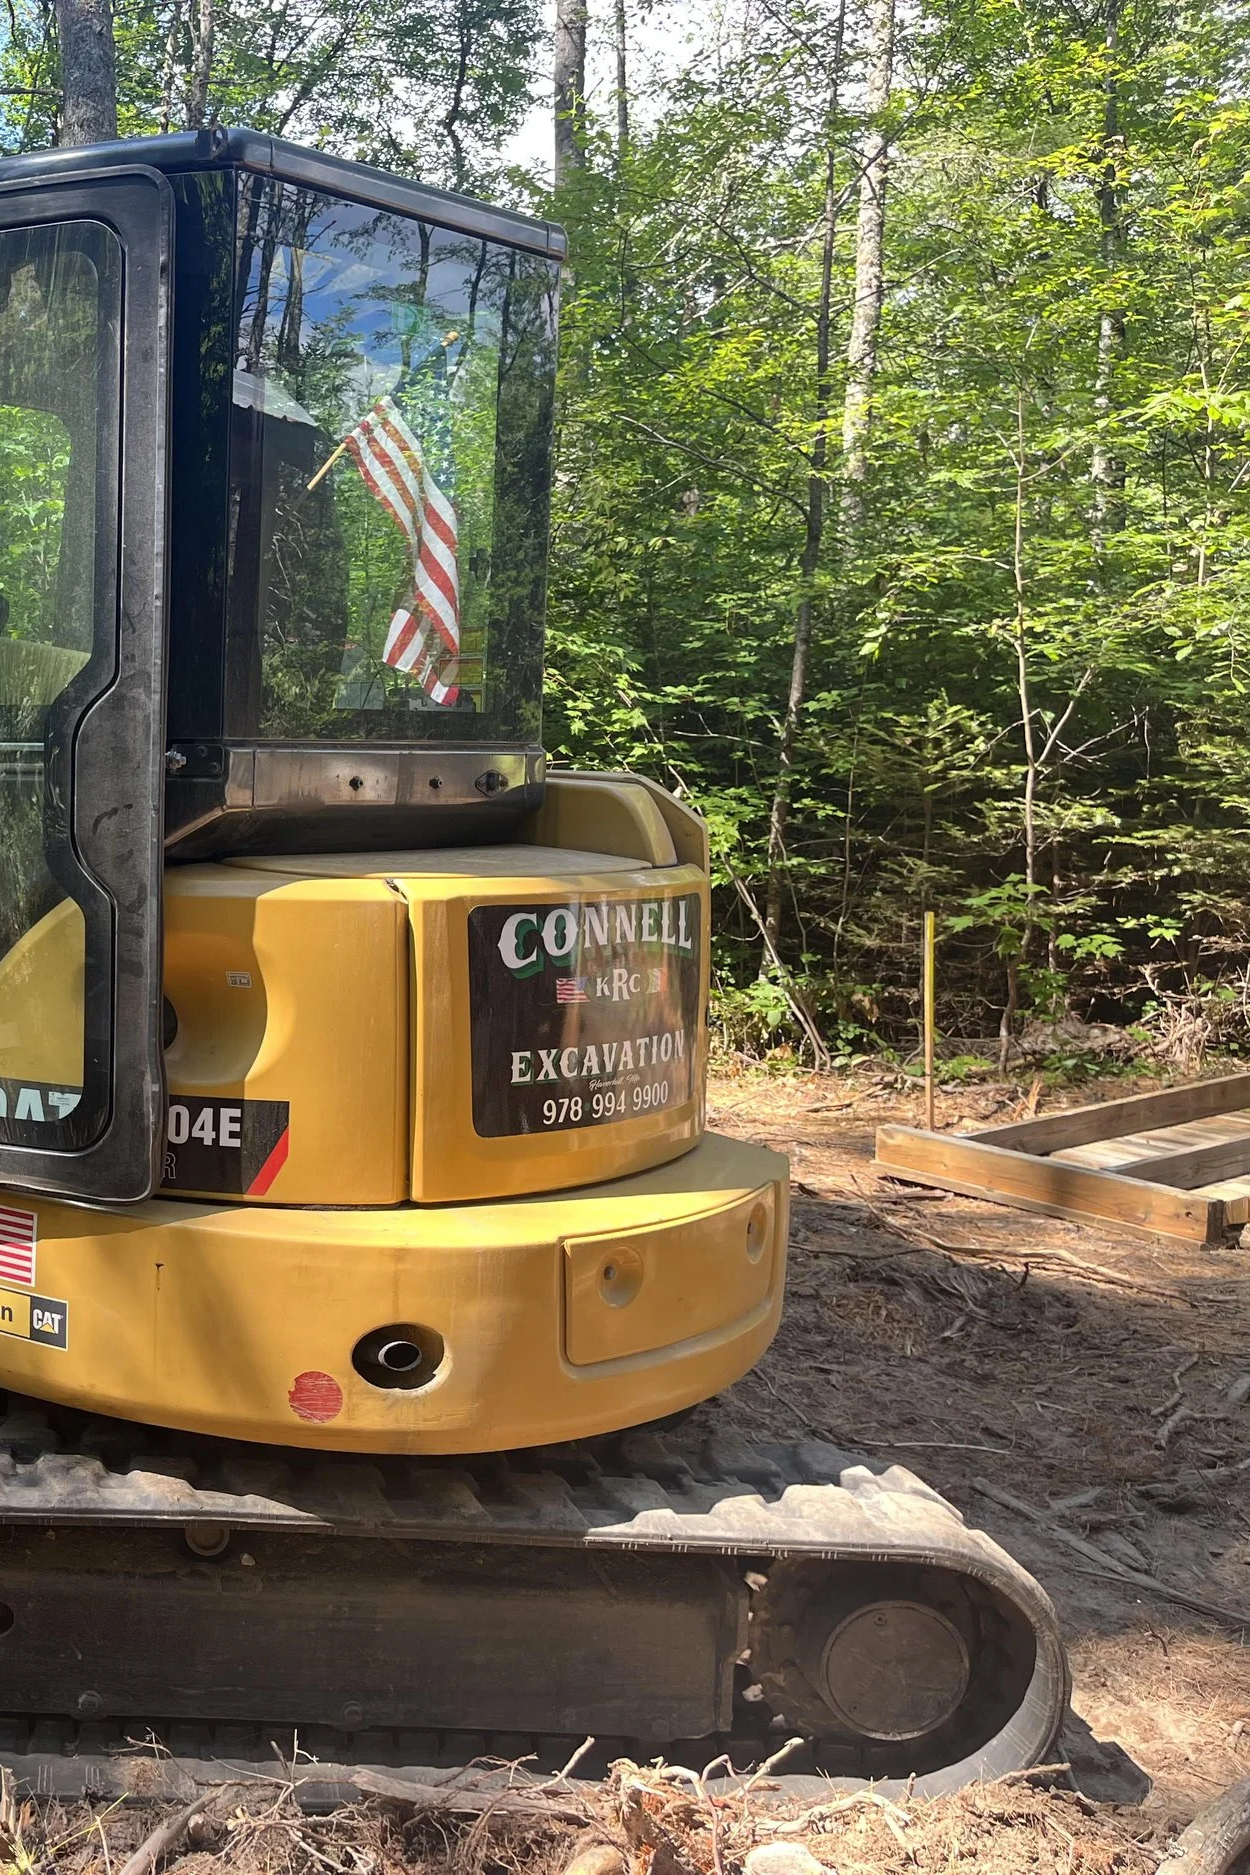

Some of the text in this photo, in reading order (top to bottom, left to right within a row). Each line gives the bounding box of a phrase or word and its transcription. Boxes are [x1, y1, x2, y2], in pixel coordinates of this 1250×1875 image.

[497, 900, 693, 971] CONNELL
[510, 1029, 686, 1084] EXCAVATION
[542, 1080, 669, 1126] 978 994 9900
[32, 1308, 64, 1335] CAT
